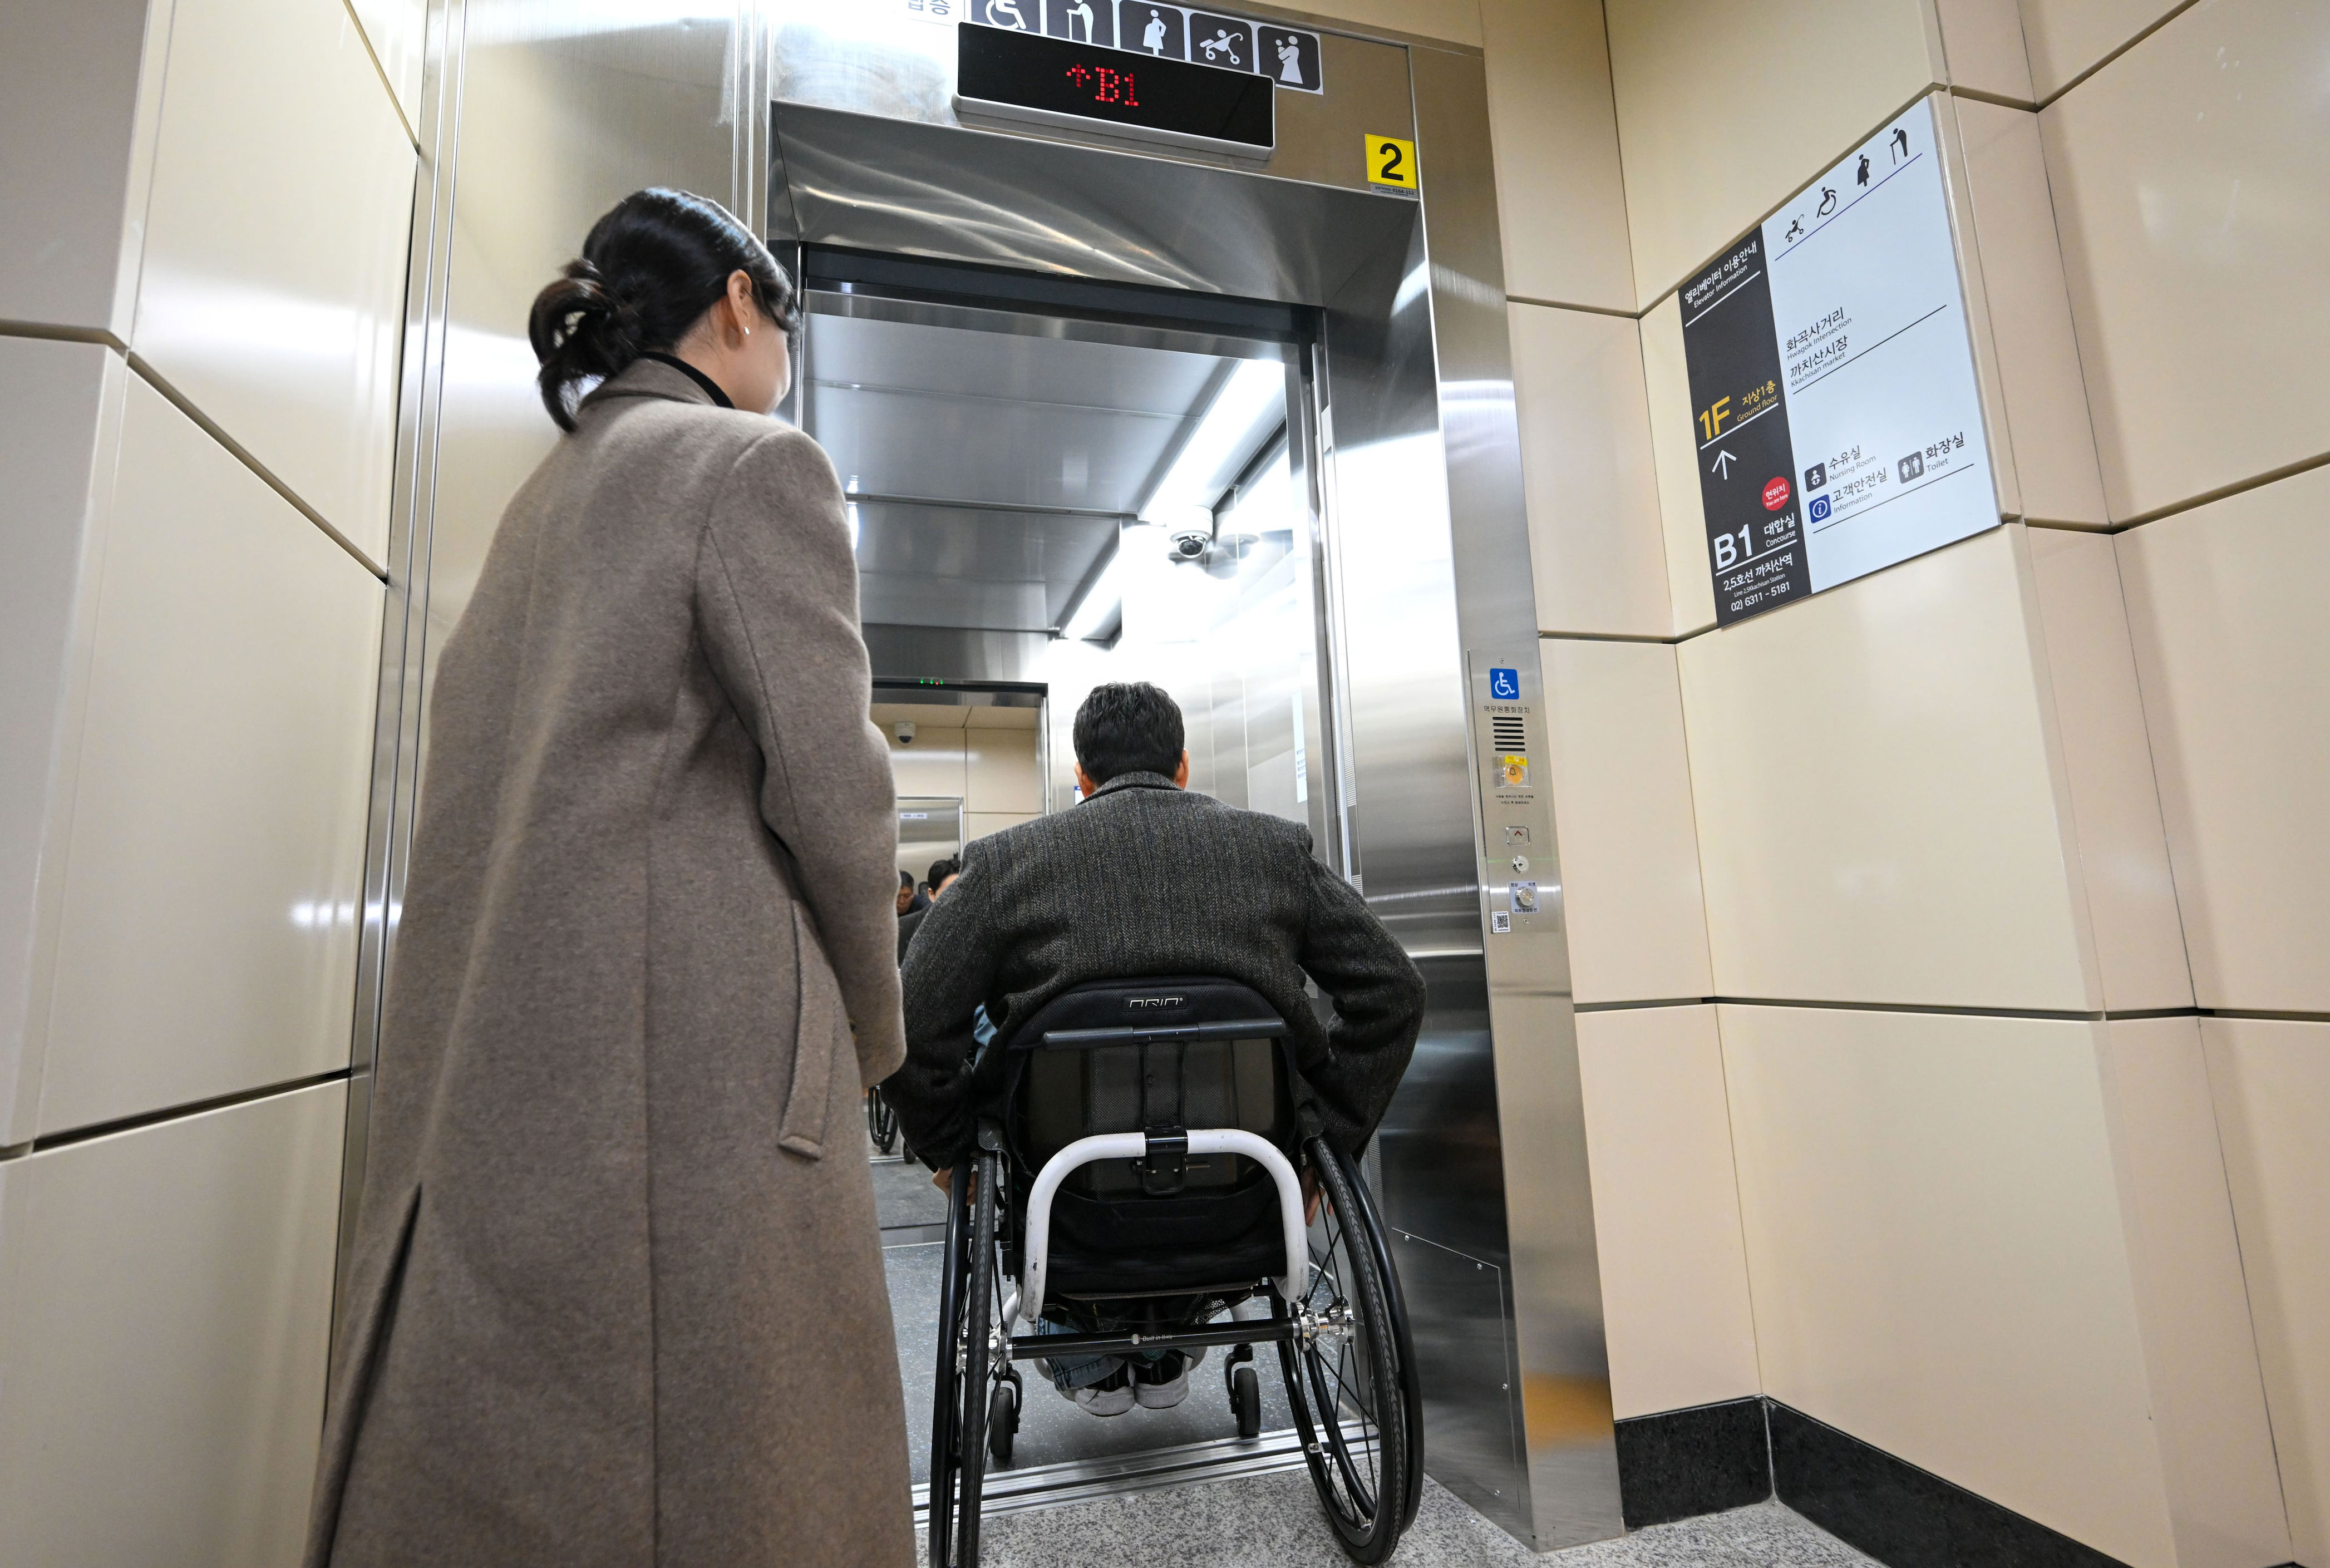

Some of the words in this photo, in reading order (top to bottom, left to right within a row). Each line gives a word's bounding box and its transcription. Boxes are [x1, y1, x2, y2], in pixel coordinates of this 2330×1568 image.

[1095, 67, 1139, 106] B1
[1380, 143, 1403, 181] 2
[1685, 268, 1722, 304] 엘리베이터
[1724, 240, 1757, 272] 이용안내
[1694, 289, 1715, 308] Elevator
[1716, 265, 1747, 292] Information
[1786, 307, 1844, 352] 화곡사거리
[1787, 342, 1812, 361] Hwagok
[1814, 318, 1852, 344] Intersection
[1790, 335, 1848, 378] 까치산시장
[1791, 367, 1821, 387] Kkachisan
[1823, 352, 1845, 369] market
[1742, 380, 1776, 405] 지상1층
[1699, 396, 1730, 440] 1F
[1737, 404, 1761, 422] Ground
[1762, 395, 1778, 407] floor
[1829, 445, 1861, 470] 수유실
[1925, 432, 1964, 459] 화장실
[1830, 466, 1855, 481] Nursing
[1856, 456, 1876, 469] Room
[1927, 458, 1948, 472] Toilet
[1766, 484, 1785, 500] 현위치
[1833, 467, 1887, 502] 고객안전실
[1834, 493, 1873, 514] Information
[1764, 512, 1795, 535] 대합실
[1766, 530, 1796, 547] Concourse
[1714, 524, 1752, 570] B1
[1723, 569, 1753, 591] 2,5호선
[1755, 553, 1793, 576] 까치산역
[1770, 574, 1785, 583] Station
[1731, 599, 1743, 612] 02)
[1745, 592, 1762, 607] 6311
[1771, 581, 1790, 596] 5181
[1484, 706, 1530, 714] 역무원통화장치
